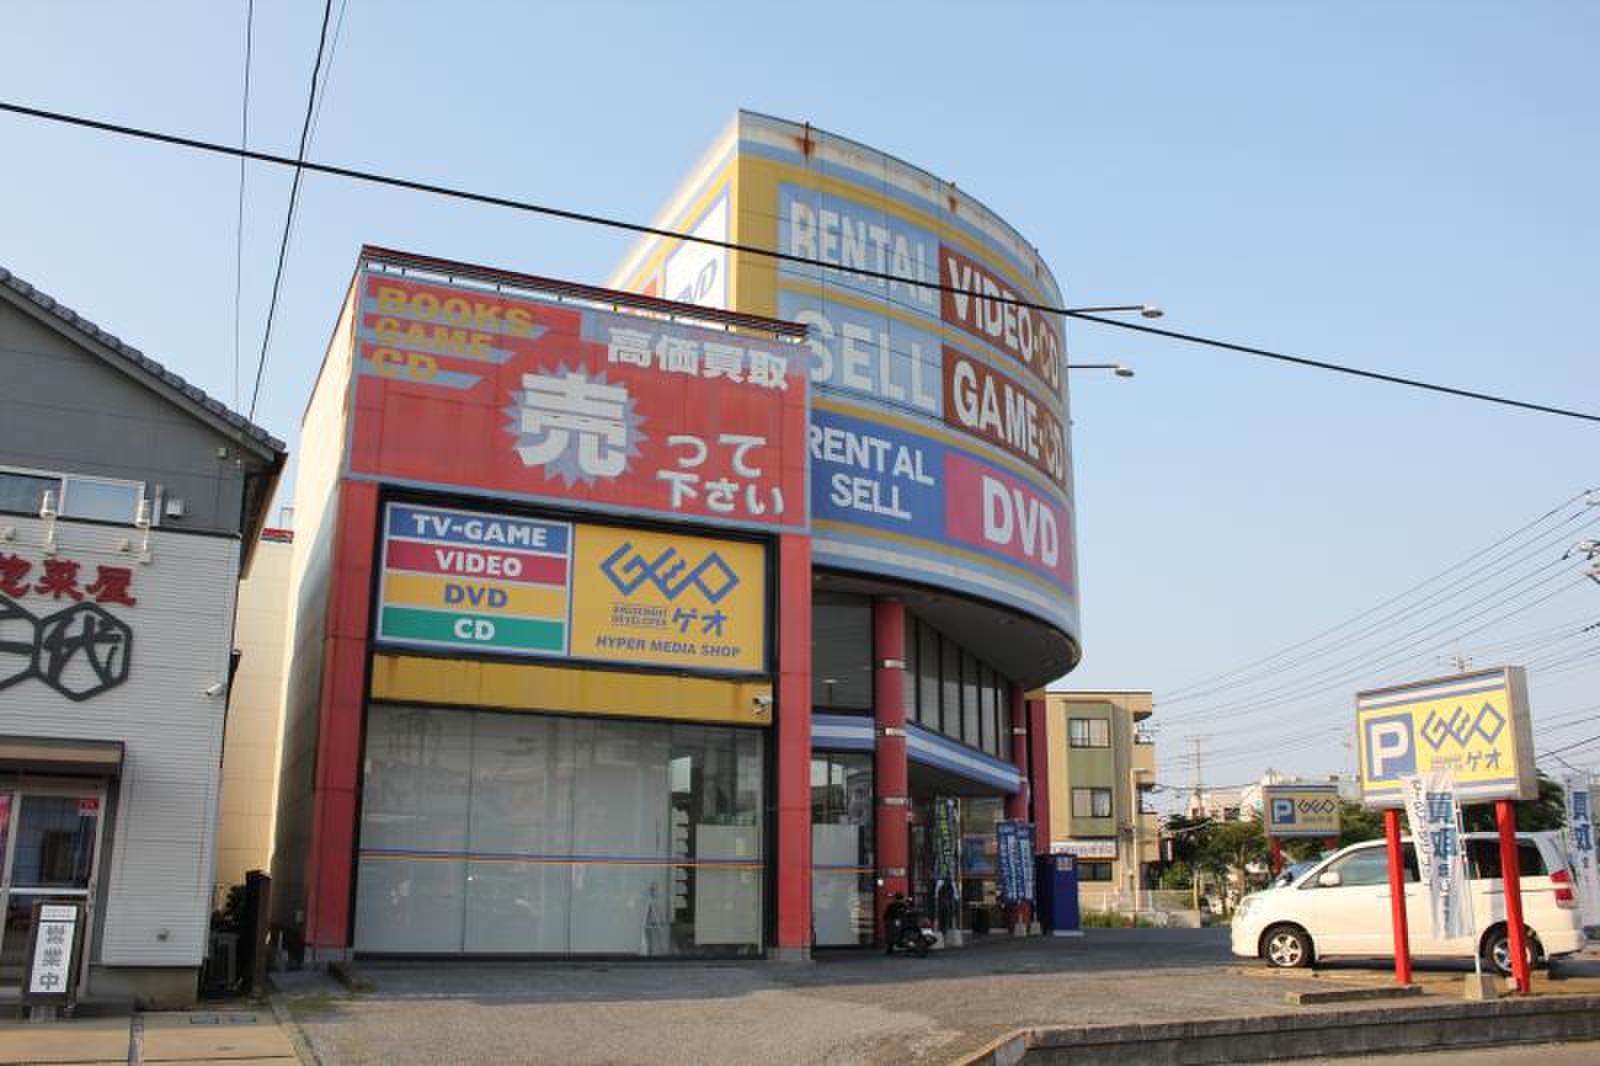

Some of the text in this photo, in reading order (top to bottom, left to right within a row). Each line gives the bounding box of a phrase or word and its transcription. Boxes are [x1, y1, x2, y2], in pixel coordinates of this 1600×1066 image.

[790, 201, 935, 305] RENTAL
[377, 286, 533, 334] BOOKS
[375, 317, 494, 358] GAME
[607, 327, 788, 391] 高価買取
[372, 348, 438, 381] CD
[795, 309, 936, 413] SELL
[518, 370, 630, 478] 売
[667, 433, 767, 478] って
[810, 424, 935, 486] RENTAL
[656, 470, 785, 515] 下さい
[831, 473, 912, 520] SELL
[412, 513, 548, 547] TV-GAME
[982, 475, 1058, 568] DVD
[435, 549, 523, 577] VIDEO
[443, 583, 509, 609] DVD
[454, 618, 496, 641] CD
[672, 607, 728, 637] ゲオ
[595, 635, 740, 657] HYPER MEDIA SHOP
[1371, 722, 1409, 777] P
[1467, 748, 1502, 770] ゲオ
[1273, 800, 1292, 823] P
